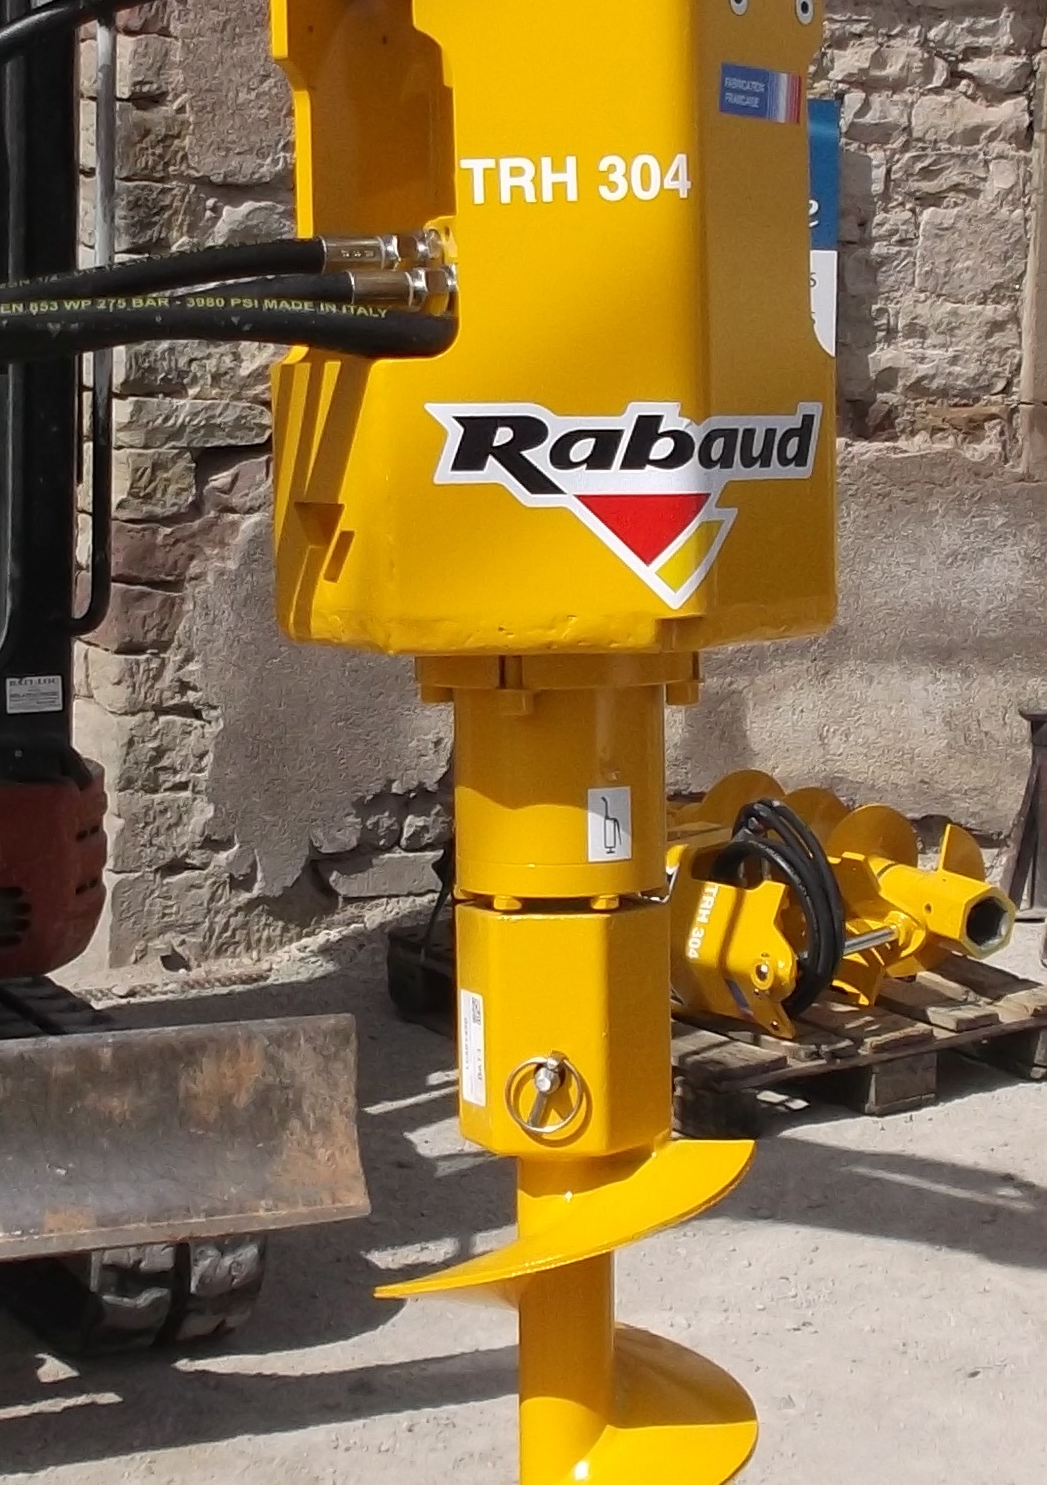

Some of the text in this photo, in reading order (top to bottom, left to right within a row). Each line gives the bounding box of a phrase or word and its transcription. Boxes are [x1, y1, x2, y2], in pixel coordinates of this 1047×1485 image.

[460, 153, 692, 205] TRH 304
[0, 302, 24, 314] EN
[62, 298, 92, 311] WP
[96, 298, 126, 311] 275
[132, 297, 169, 309] BAR
[230, 297, 258, 308] PSI
[264, 298, 315, 312] MADE
[320, 302, 338, 313] IN
[342, 302, 388, 318] ITALY
[450, 413, 816, 496] Rabaud
[687, 883, 719, 959] TRH 304
